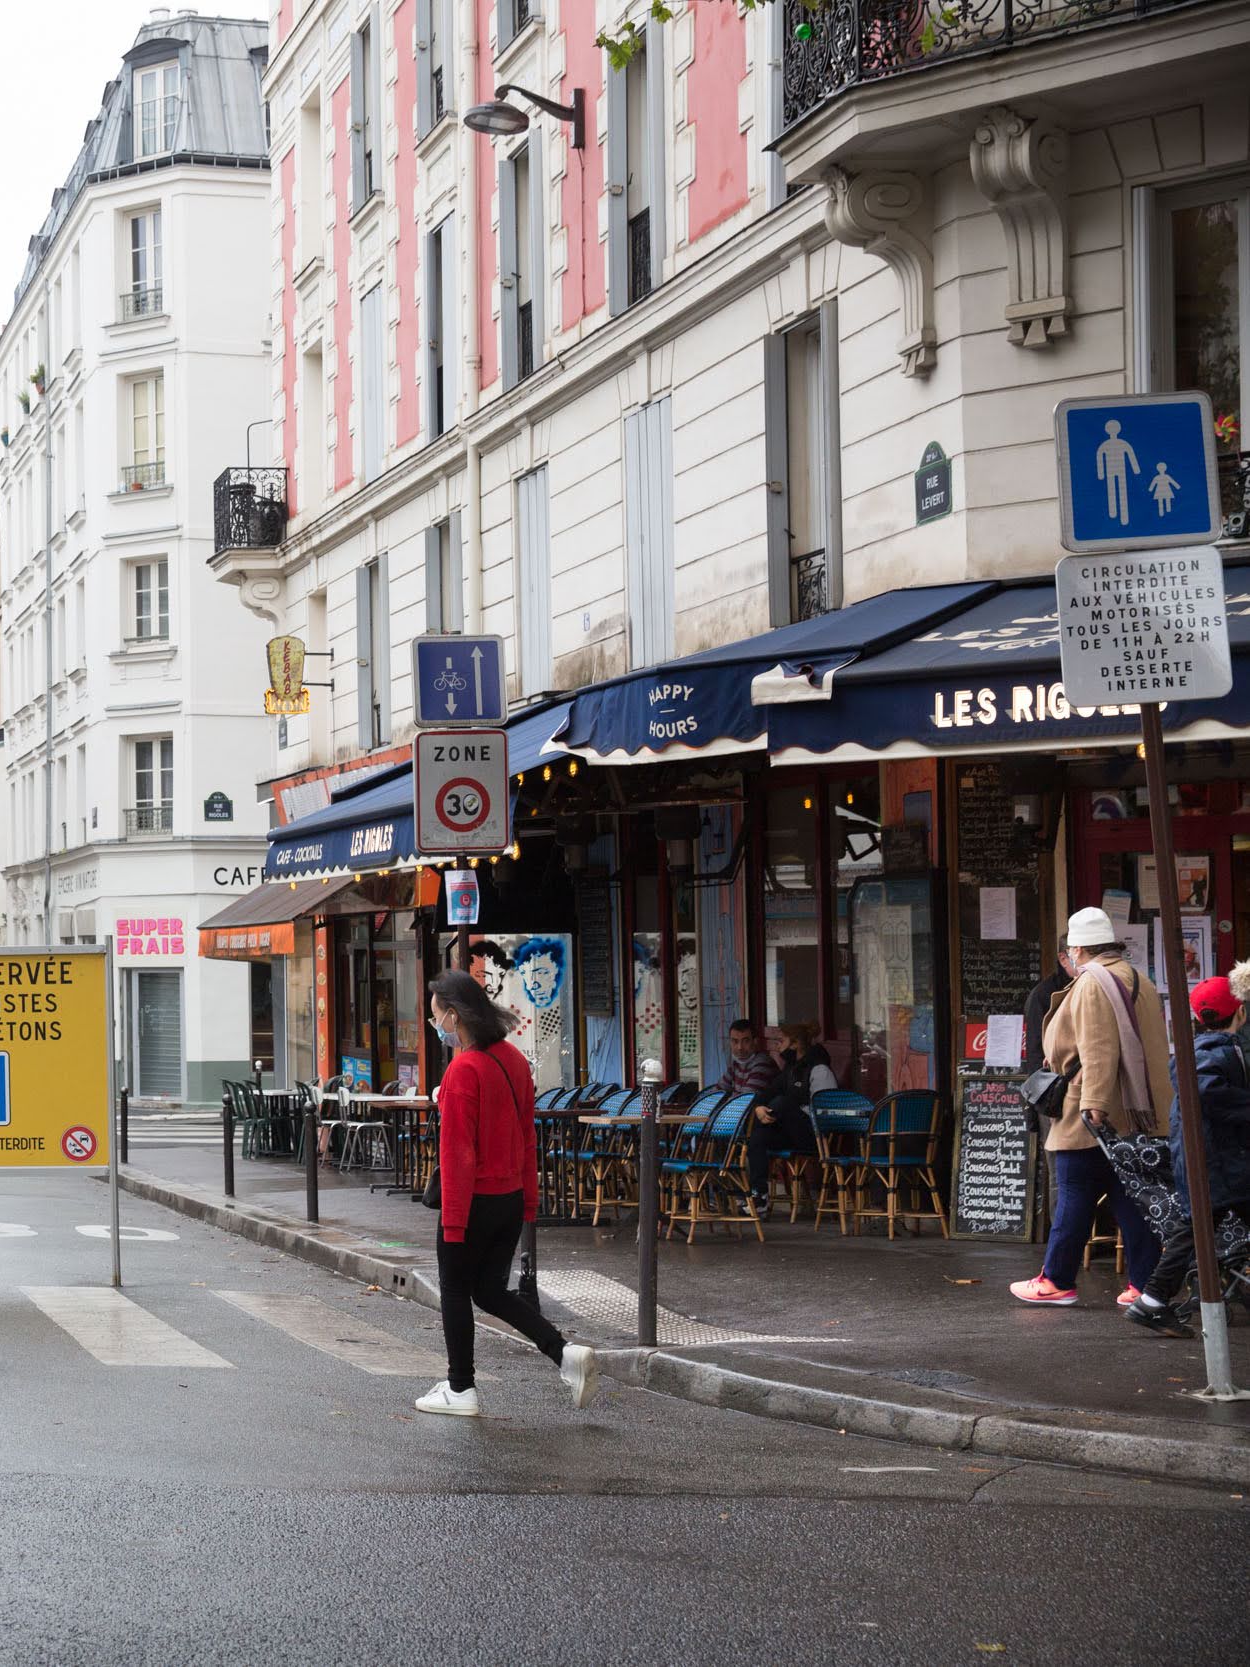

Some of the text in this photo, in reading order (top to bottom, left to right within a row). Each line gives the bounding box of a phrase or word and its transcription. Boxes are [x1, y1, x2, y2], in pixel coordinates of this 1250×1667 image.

[926, 475, 939, 490] RUE
[921, 491, 945, 510] LEVERT
[1081, 560, 1200, 579] CIRCULATION
[1093, 575, 1189, 592] INTERDITE
[1070, 597, 1102, 608] AUX
[1114, 587, 1216, 605] VÉHICULES
[1091, 602, 1196, 621] MOTORISÉS
[1067, 616, 1222, 638] TOUS LES JOURS
[1081, 639, 1102, 651] DE
[1154, 632, 1163, 645] À
[1123, 648, 1169, 662] SAUF
[283, 640, 291, 695] KEBAB
[1101, 661, 1193, 678] DESSERTE
[1108, 675, 1187, 691] INTERNE
[648, 684, 695, 706] HAPPY
[934, 687, 997, 728] LES
[649, 716, 698, 738] HOURS
[433, 745, 491, 762] ZONE
[446, 793, 480, 816] 30
[351, 823, 394, 857] LES RIGOLES
[294, 844, 323, 863] COCKTAILS
[116, 918, 184, 936] SUPER
[116, 937, 185, 955] FRAIS
[1001, 1120, 1027, 1136] Royal
